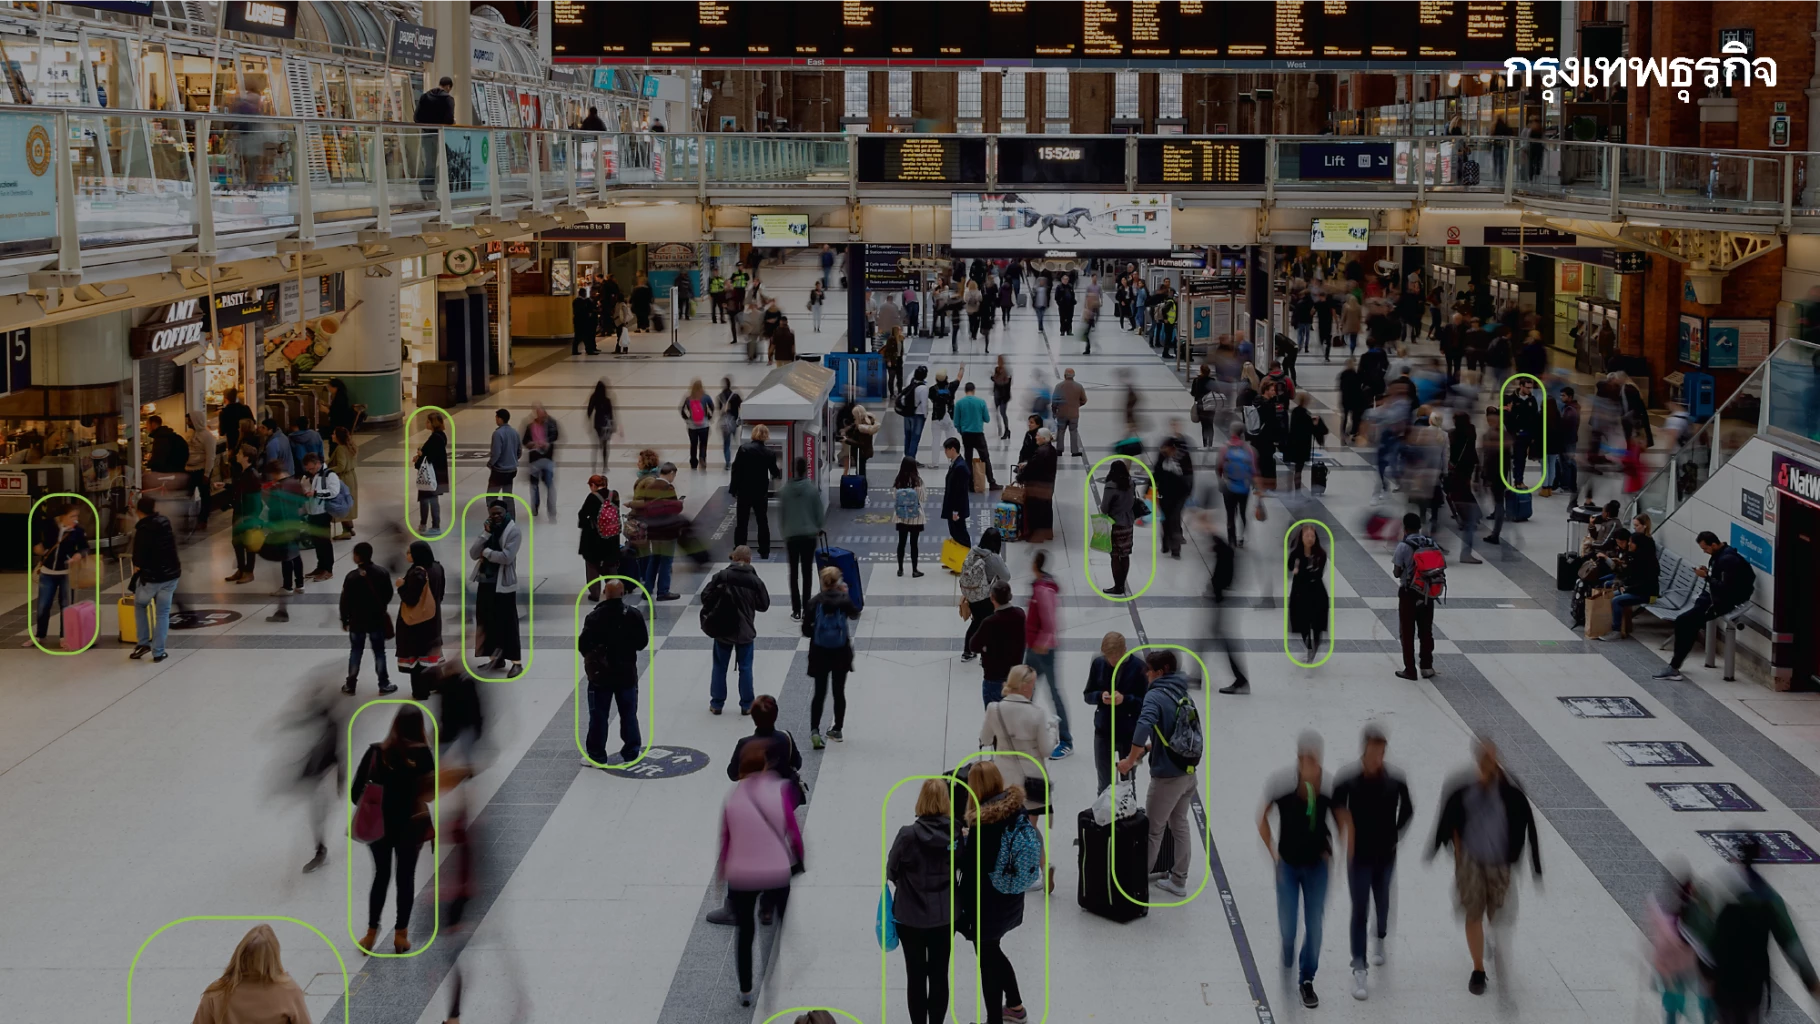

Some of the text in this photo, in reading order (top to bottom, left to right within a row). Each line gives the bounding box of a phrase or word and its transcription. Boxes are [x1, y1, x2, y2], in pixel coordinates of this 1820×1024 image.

[1324, 155, 1345, 167] Lift
[222, 292, 244, 308] PASTY
[165, 298, 198, 324] AMT
[15, 330, 26, 361] 5
[152, 322, 203, 352] COFFEE
[617, 763, 664, 776] ift
